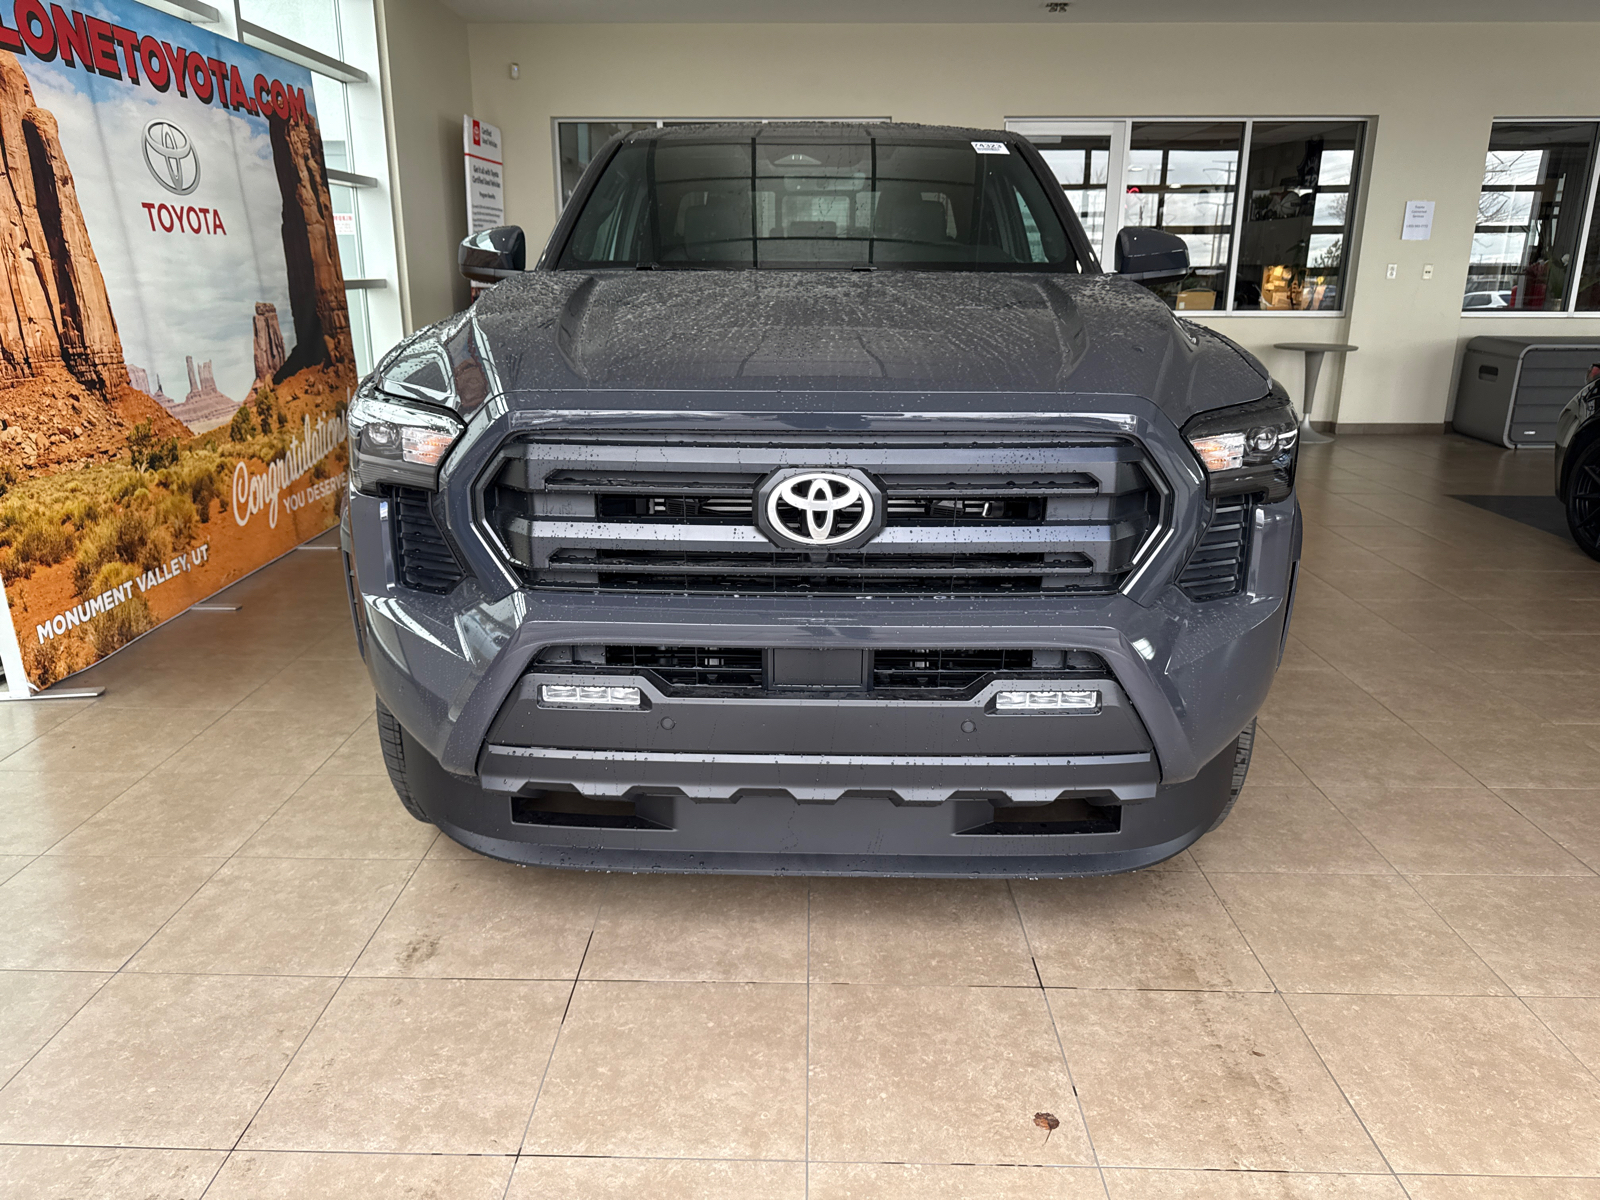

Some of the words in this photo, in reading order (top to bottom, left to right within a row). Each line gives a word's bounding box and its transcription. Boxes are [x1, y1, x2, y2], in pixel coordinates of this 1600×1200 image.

[141, 201, 227, 236] TOYOTA
[283, 490, 306, 514] YOU
[306, 472, 348, 504] DESERVE
[36, 580, 133, 645] MONUMENT
[135, 553, 192, 593] VALLEY,
[191, 544, 209, 566] UT
